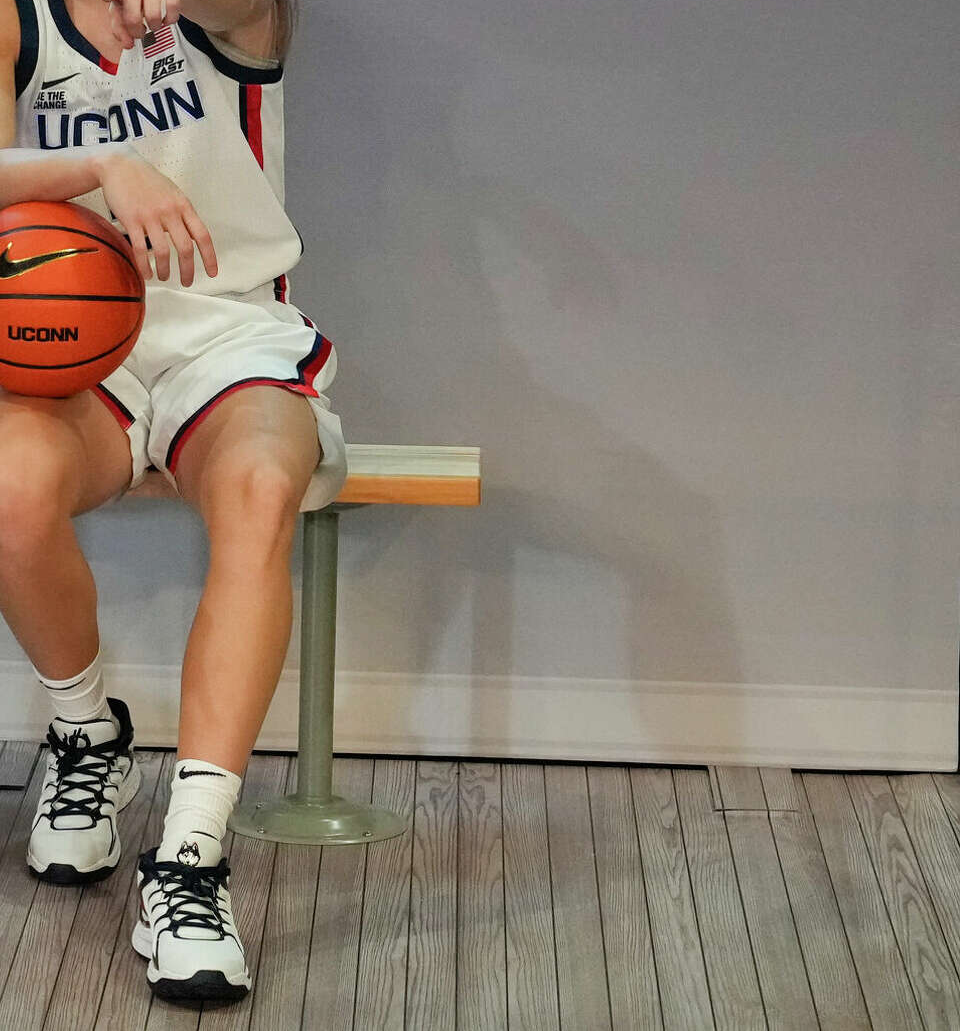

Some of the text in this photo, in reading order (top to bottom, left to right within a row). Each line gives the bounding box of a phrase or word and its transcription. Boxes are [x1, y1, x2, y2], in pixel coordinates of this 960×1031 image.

[151, 59, 185, 80] EAST
[152, 54, 175, 71] BIG
[47, 91, 66, 100] THE
[37, 80, 206, 150] UCONN
[8, 325, 79, 342] UCONN
